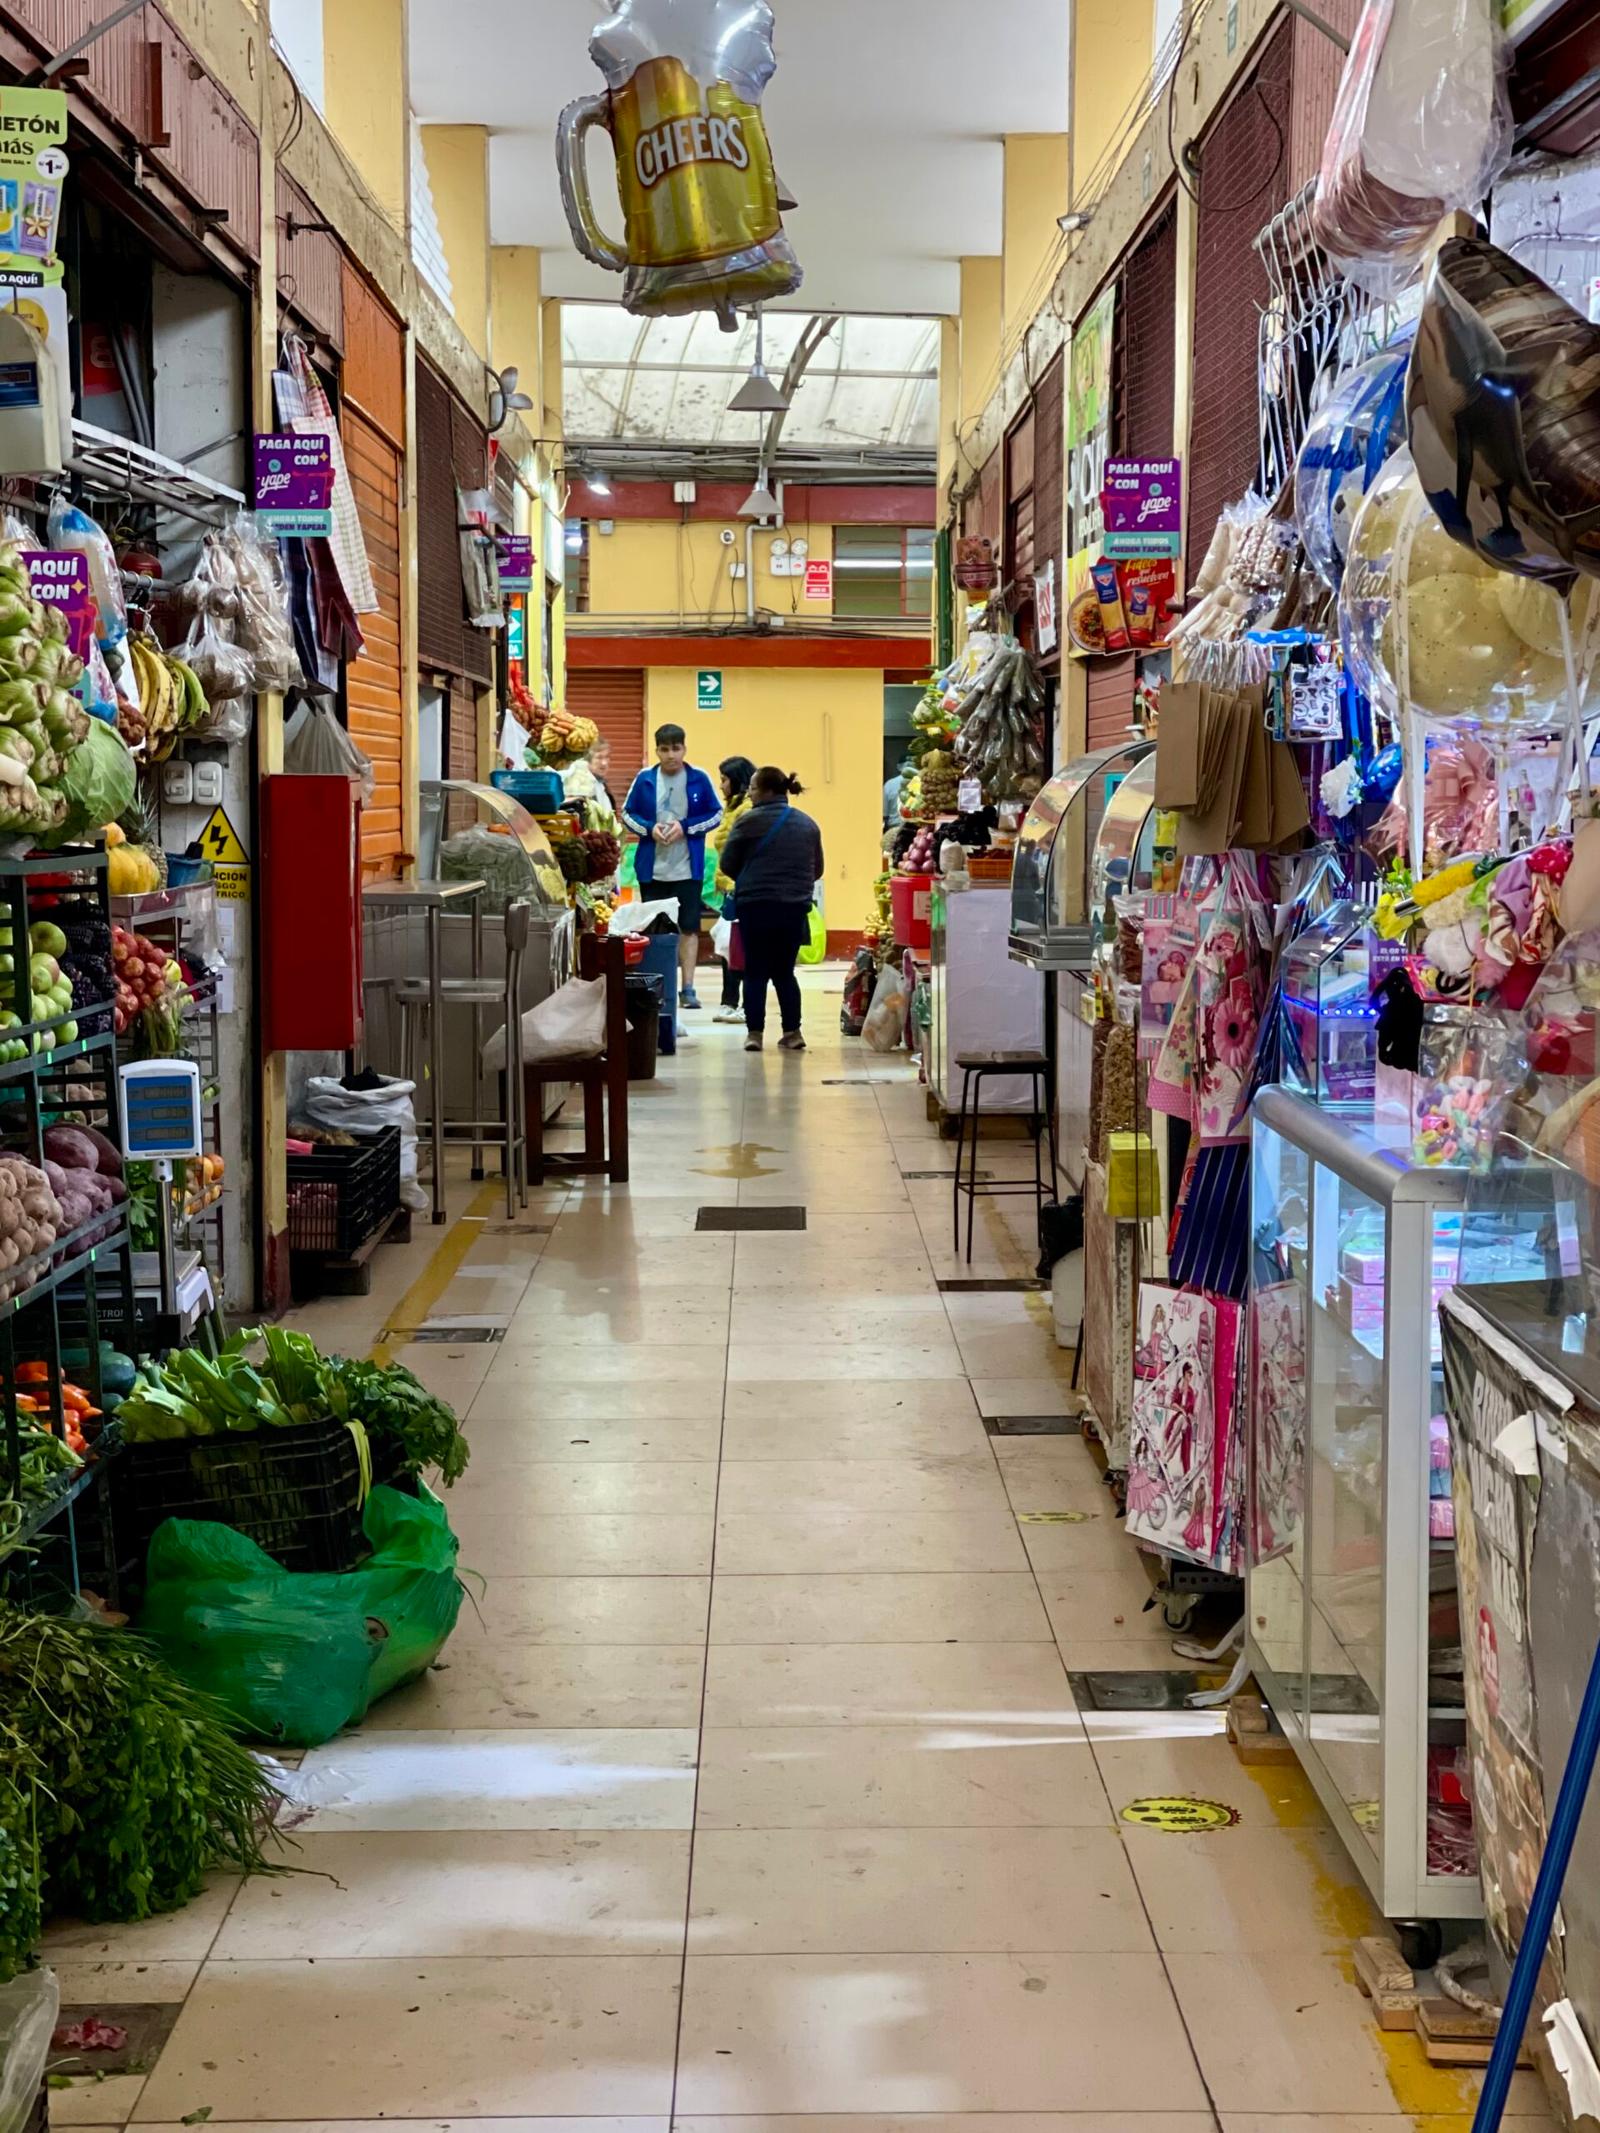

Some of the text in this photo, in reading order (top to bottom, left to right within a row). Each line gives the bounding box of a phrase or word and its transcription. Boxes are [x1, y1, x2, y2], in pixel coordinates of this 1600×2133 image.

[0, 114, 60, 134] ETÓN
[636, 116, 749, 187] CHEERS
[8, 273, 38, 285] AQUÍ!
[258, 437, 324, 451] PAGA AQUÍ
[294, 455, 319, 465] CON
[1108, 462, 1173, 475] PAGA AQUÍ
[256, 473, 291, 499] yape
[1115, 479, 1139, 489] CON
[1137, 496, 1172, 523] yape
[30, 557, 79, 578] AQUÍ
[31, 584, 70, 600] CON
[216, 890, 245, 898] TRICO
